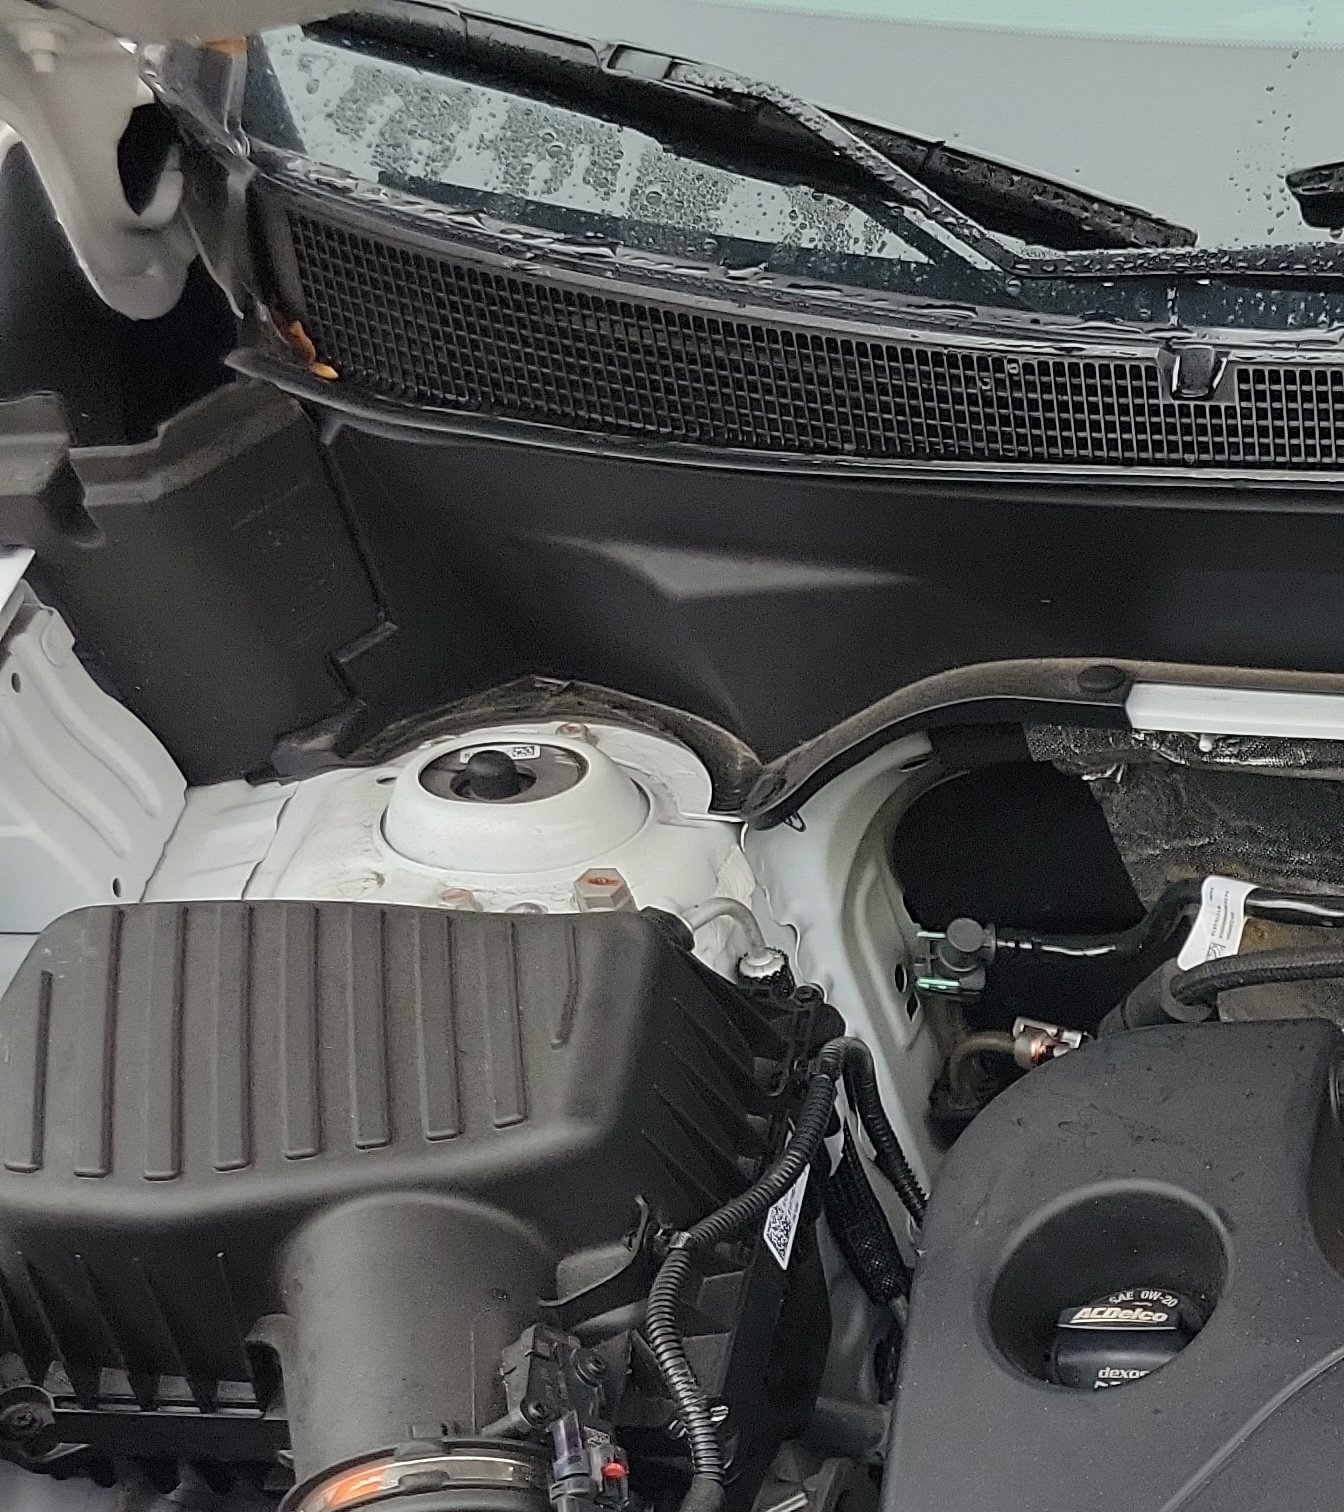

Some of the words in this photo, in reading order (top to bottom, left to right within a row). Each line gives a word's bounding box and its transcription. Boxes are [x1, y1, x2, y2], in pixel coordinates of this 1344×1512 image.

[1109, 1291, 1134, 1304] SAE
[1140, 1290, 1179, 1308] 0W-20
[1073, 1307, 1168, 1322] ACDelco
